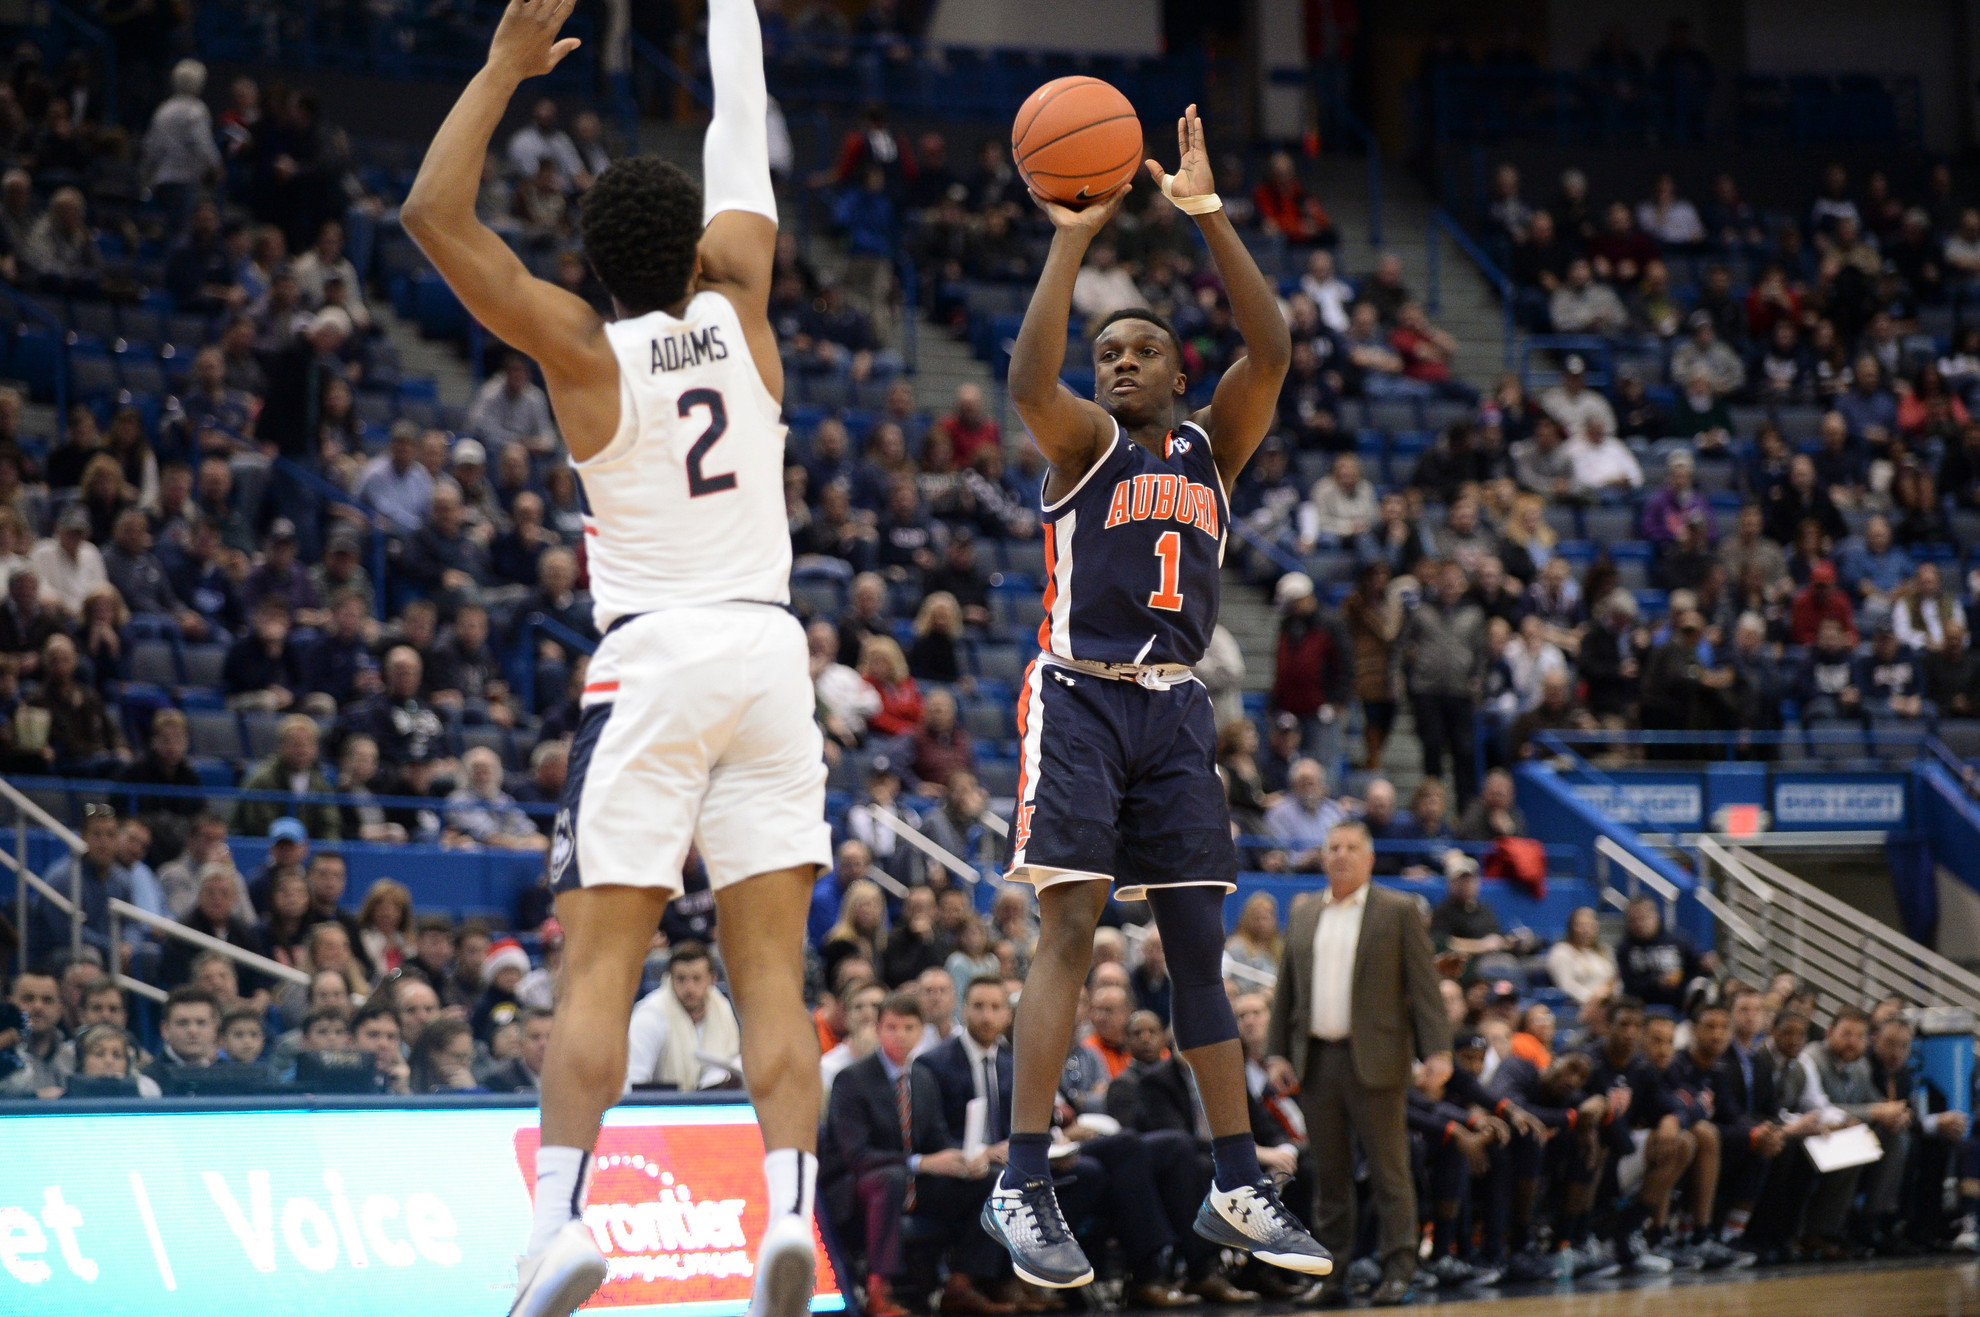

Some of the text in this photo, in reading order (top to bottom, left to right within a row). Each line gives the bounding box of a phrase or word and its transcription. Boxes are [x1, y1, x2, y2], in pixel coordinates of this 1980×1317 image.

[650, 325, 729, 375] ADAMS
[677, 387, 738, 499] 2
[1104, 473, 1219, 541] AUBURN
[1147, 530, 1184, 612] 1
[202, 1168, 462, 1273] Voice
[581, 1189, 746, 1254] rontier
